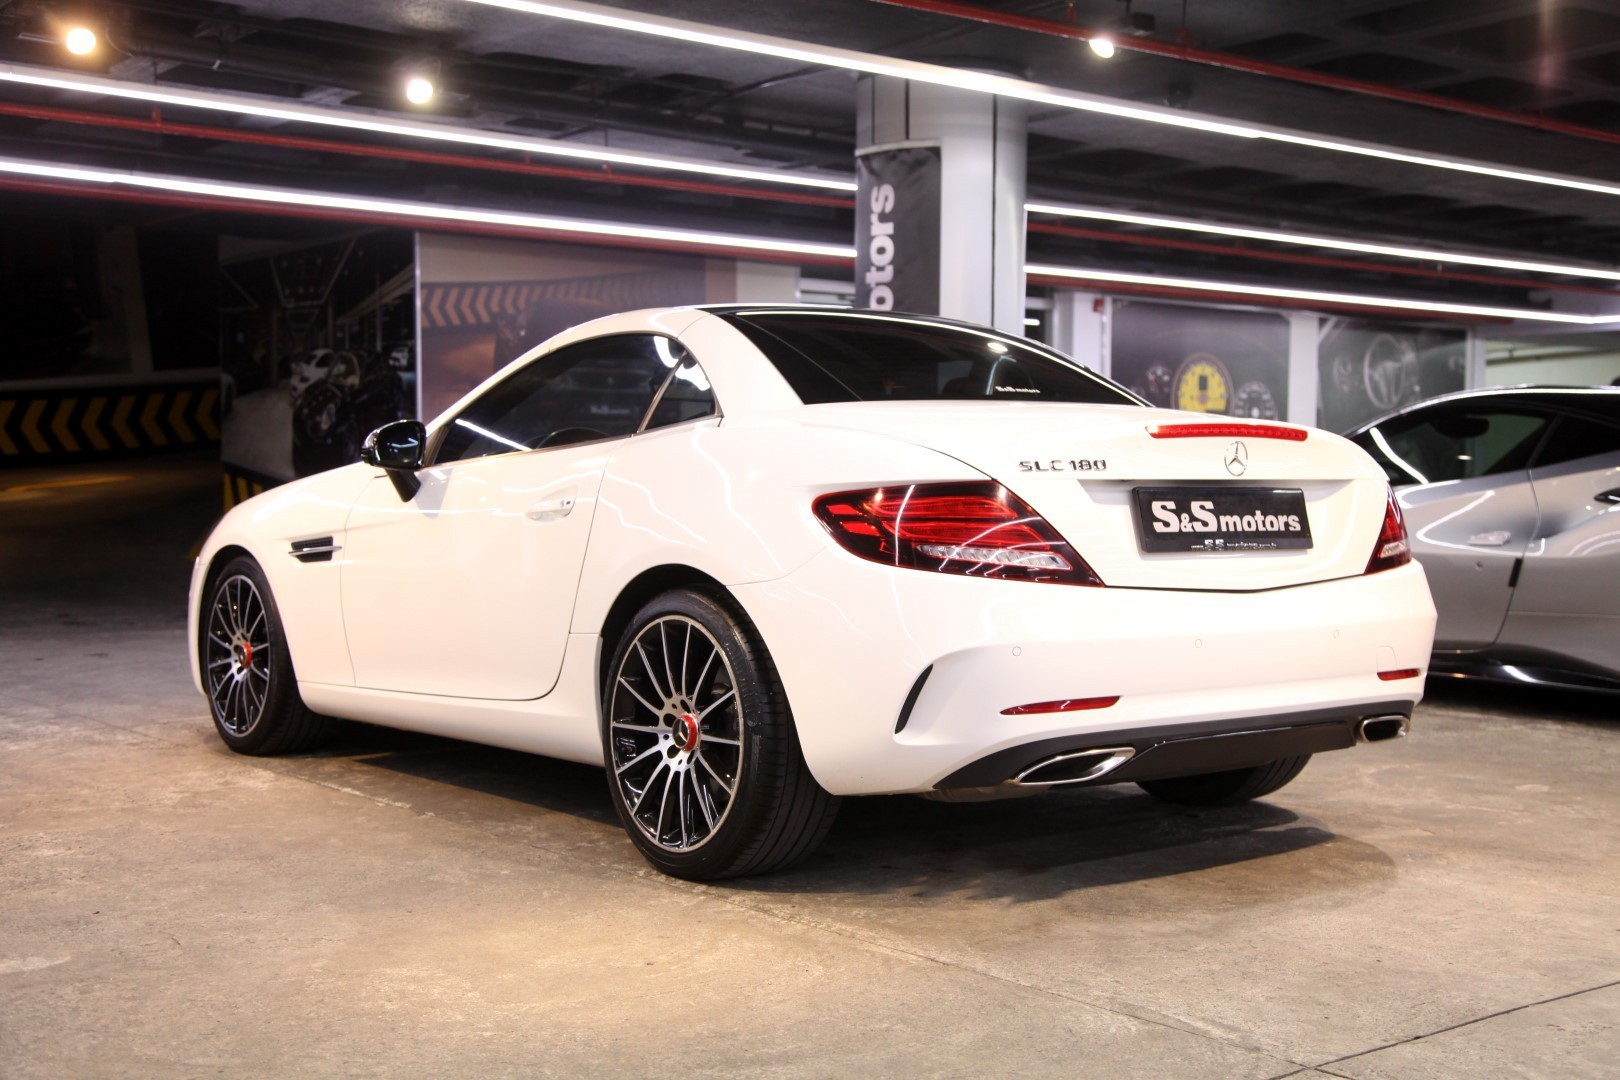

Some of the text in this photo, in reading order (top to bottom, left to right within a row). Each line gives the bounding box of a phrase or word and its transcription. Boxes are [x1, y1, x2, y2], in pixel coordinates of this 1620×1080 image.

[1018, 459, 1107, 472] SLC 180
[1151, 500, 1301, 533] S&S motors
